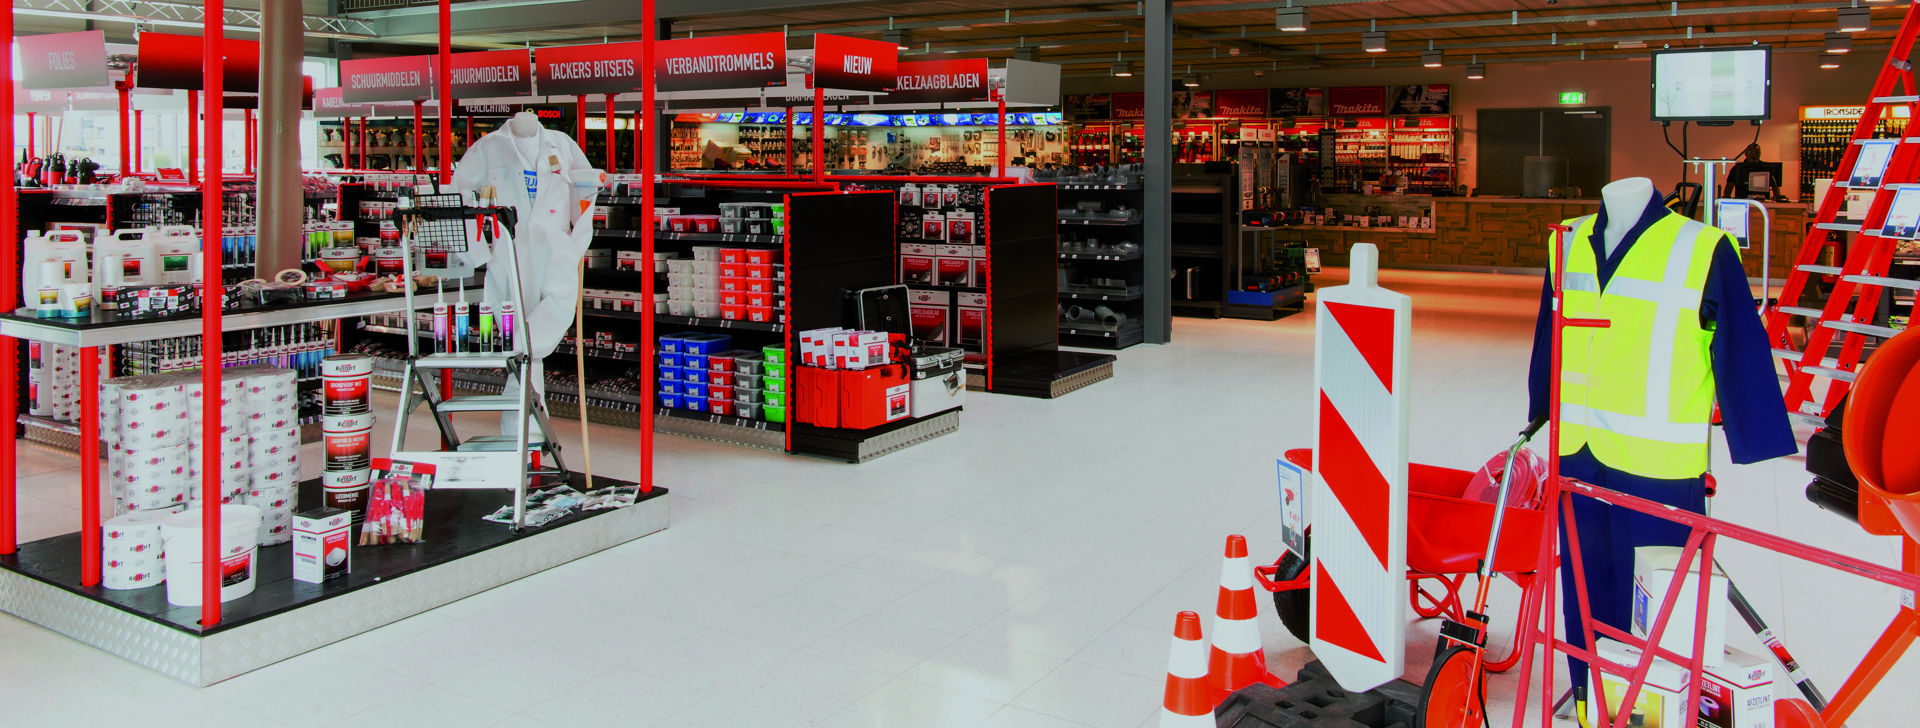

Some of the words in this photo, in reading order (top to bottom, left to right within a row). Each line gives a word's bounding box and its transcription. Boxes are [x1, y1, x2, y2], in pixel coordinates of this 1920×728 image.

[48, 51, 76, 71] FOLIES
[549, 61, 592, 80] TACKERS
[594, 59, 635, 78] BITSETS
[665, 52, 775, 75] VERBANDTROMMELS
[843, 54, 873, 75] NIEUW
[351, 70, 421, 89] SCHUURMIDDELEN
[1823, 108, 1864, 116] IRONSIDE
[335, 475, 357, 484] Kelfort
